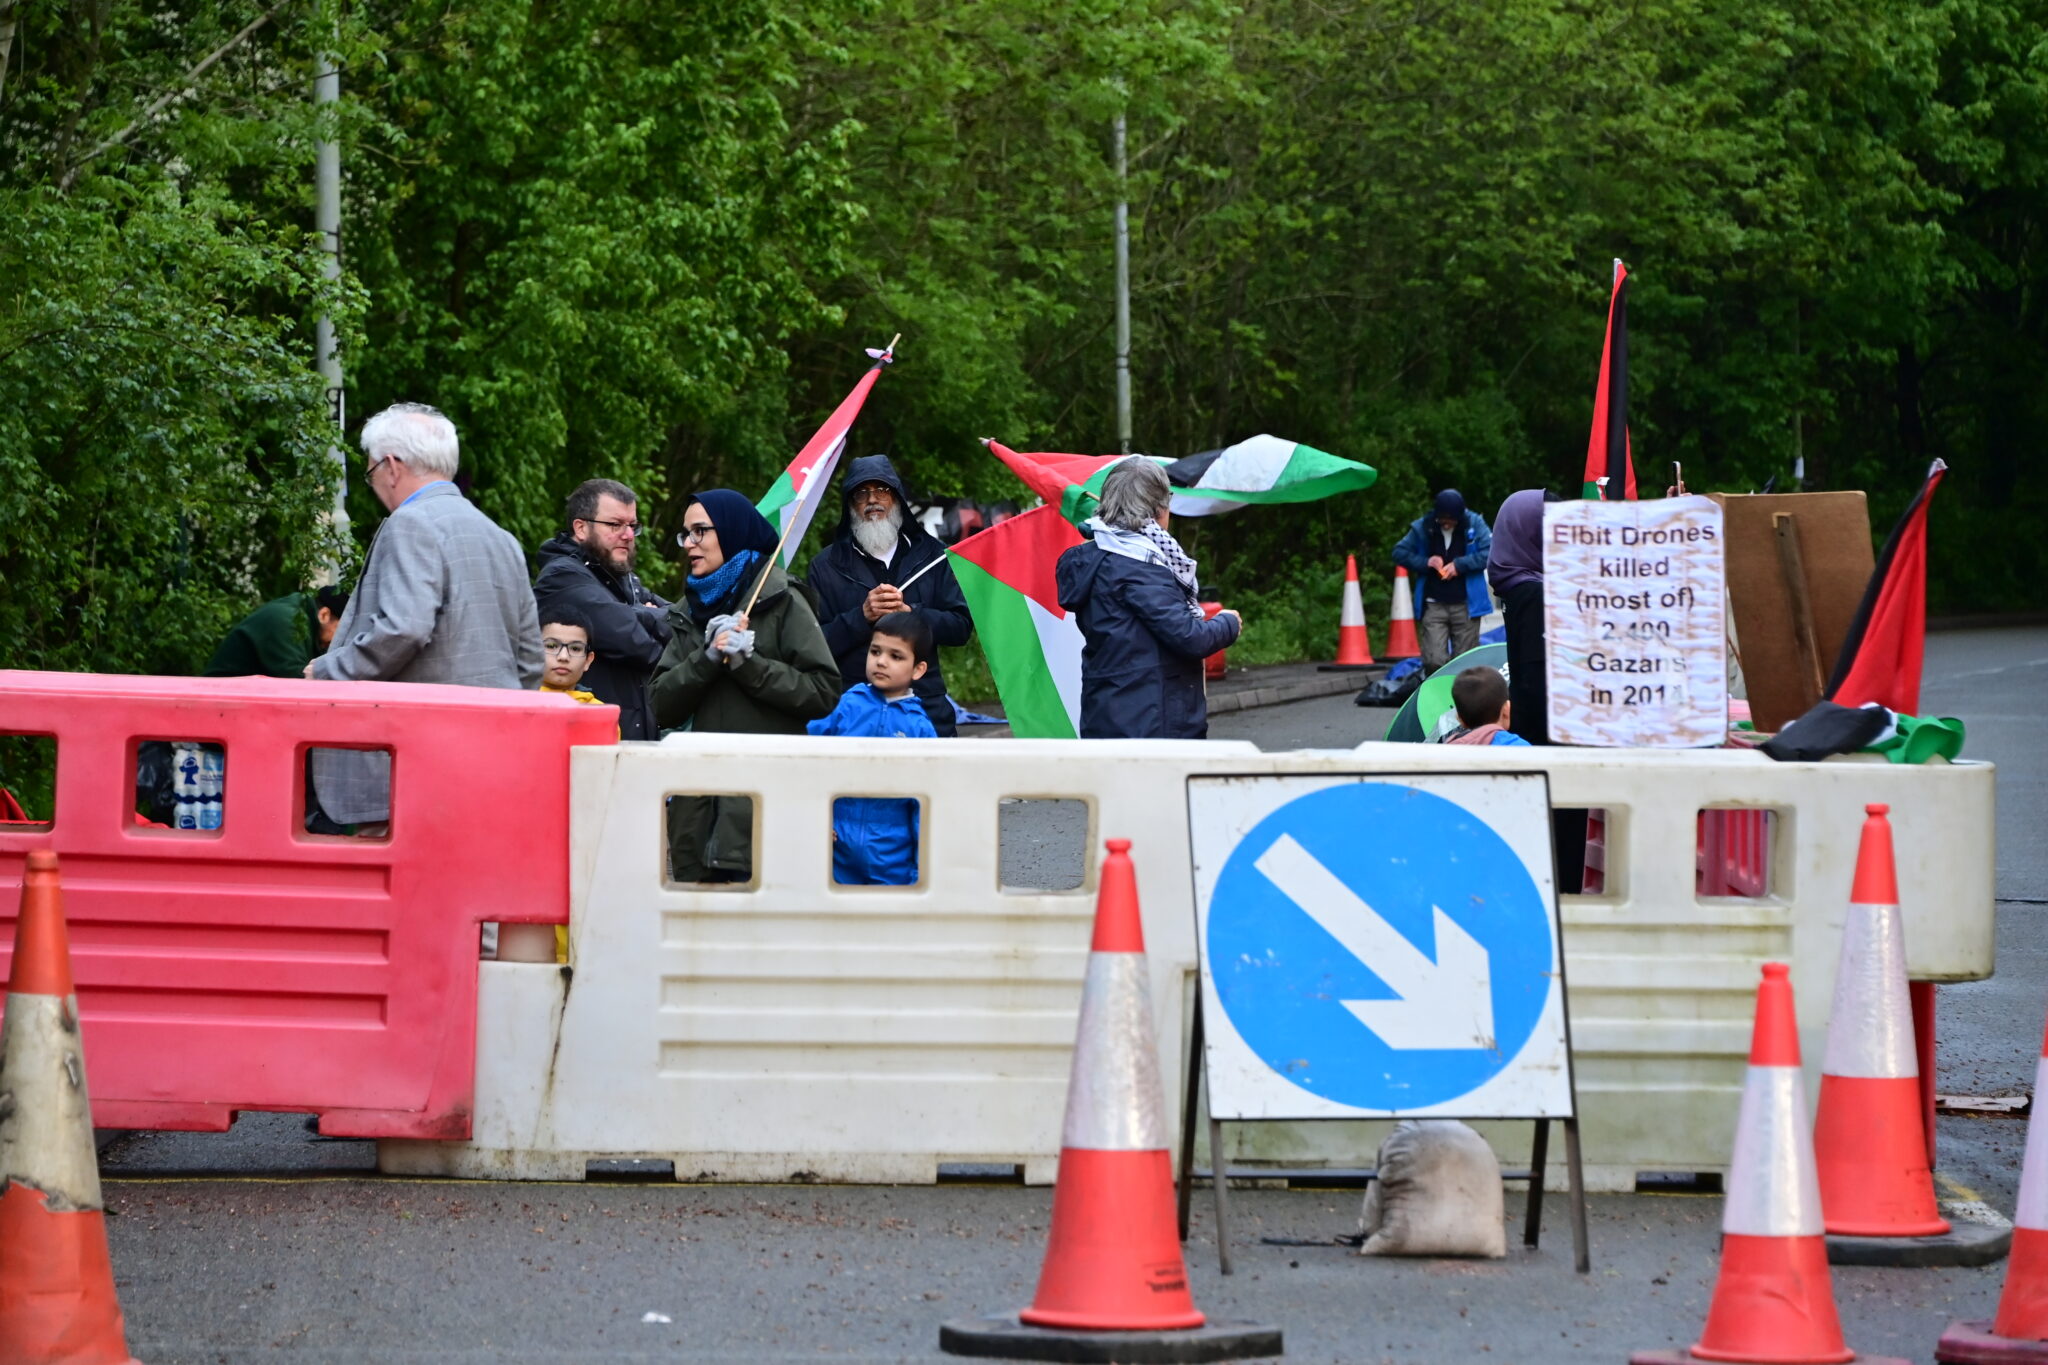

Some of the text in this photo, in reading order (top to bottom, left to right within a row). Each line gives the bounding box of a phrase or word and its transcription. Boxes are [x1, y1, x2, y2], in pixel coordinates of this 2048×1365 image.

[1553, 524, 1715, 546] Elbit Drones
[1600, 556, 1669, 578] killed
[1576, 586, 1695, 613] (most of)
[1588, 652, 1686, 673] Gazans
[1591, 684, 1612, 705] in
